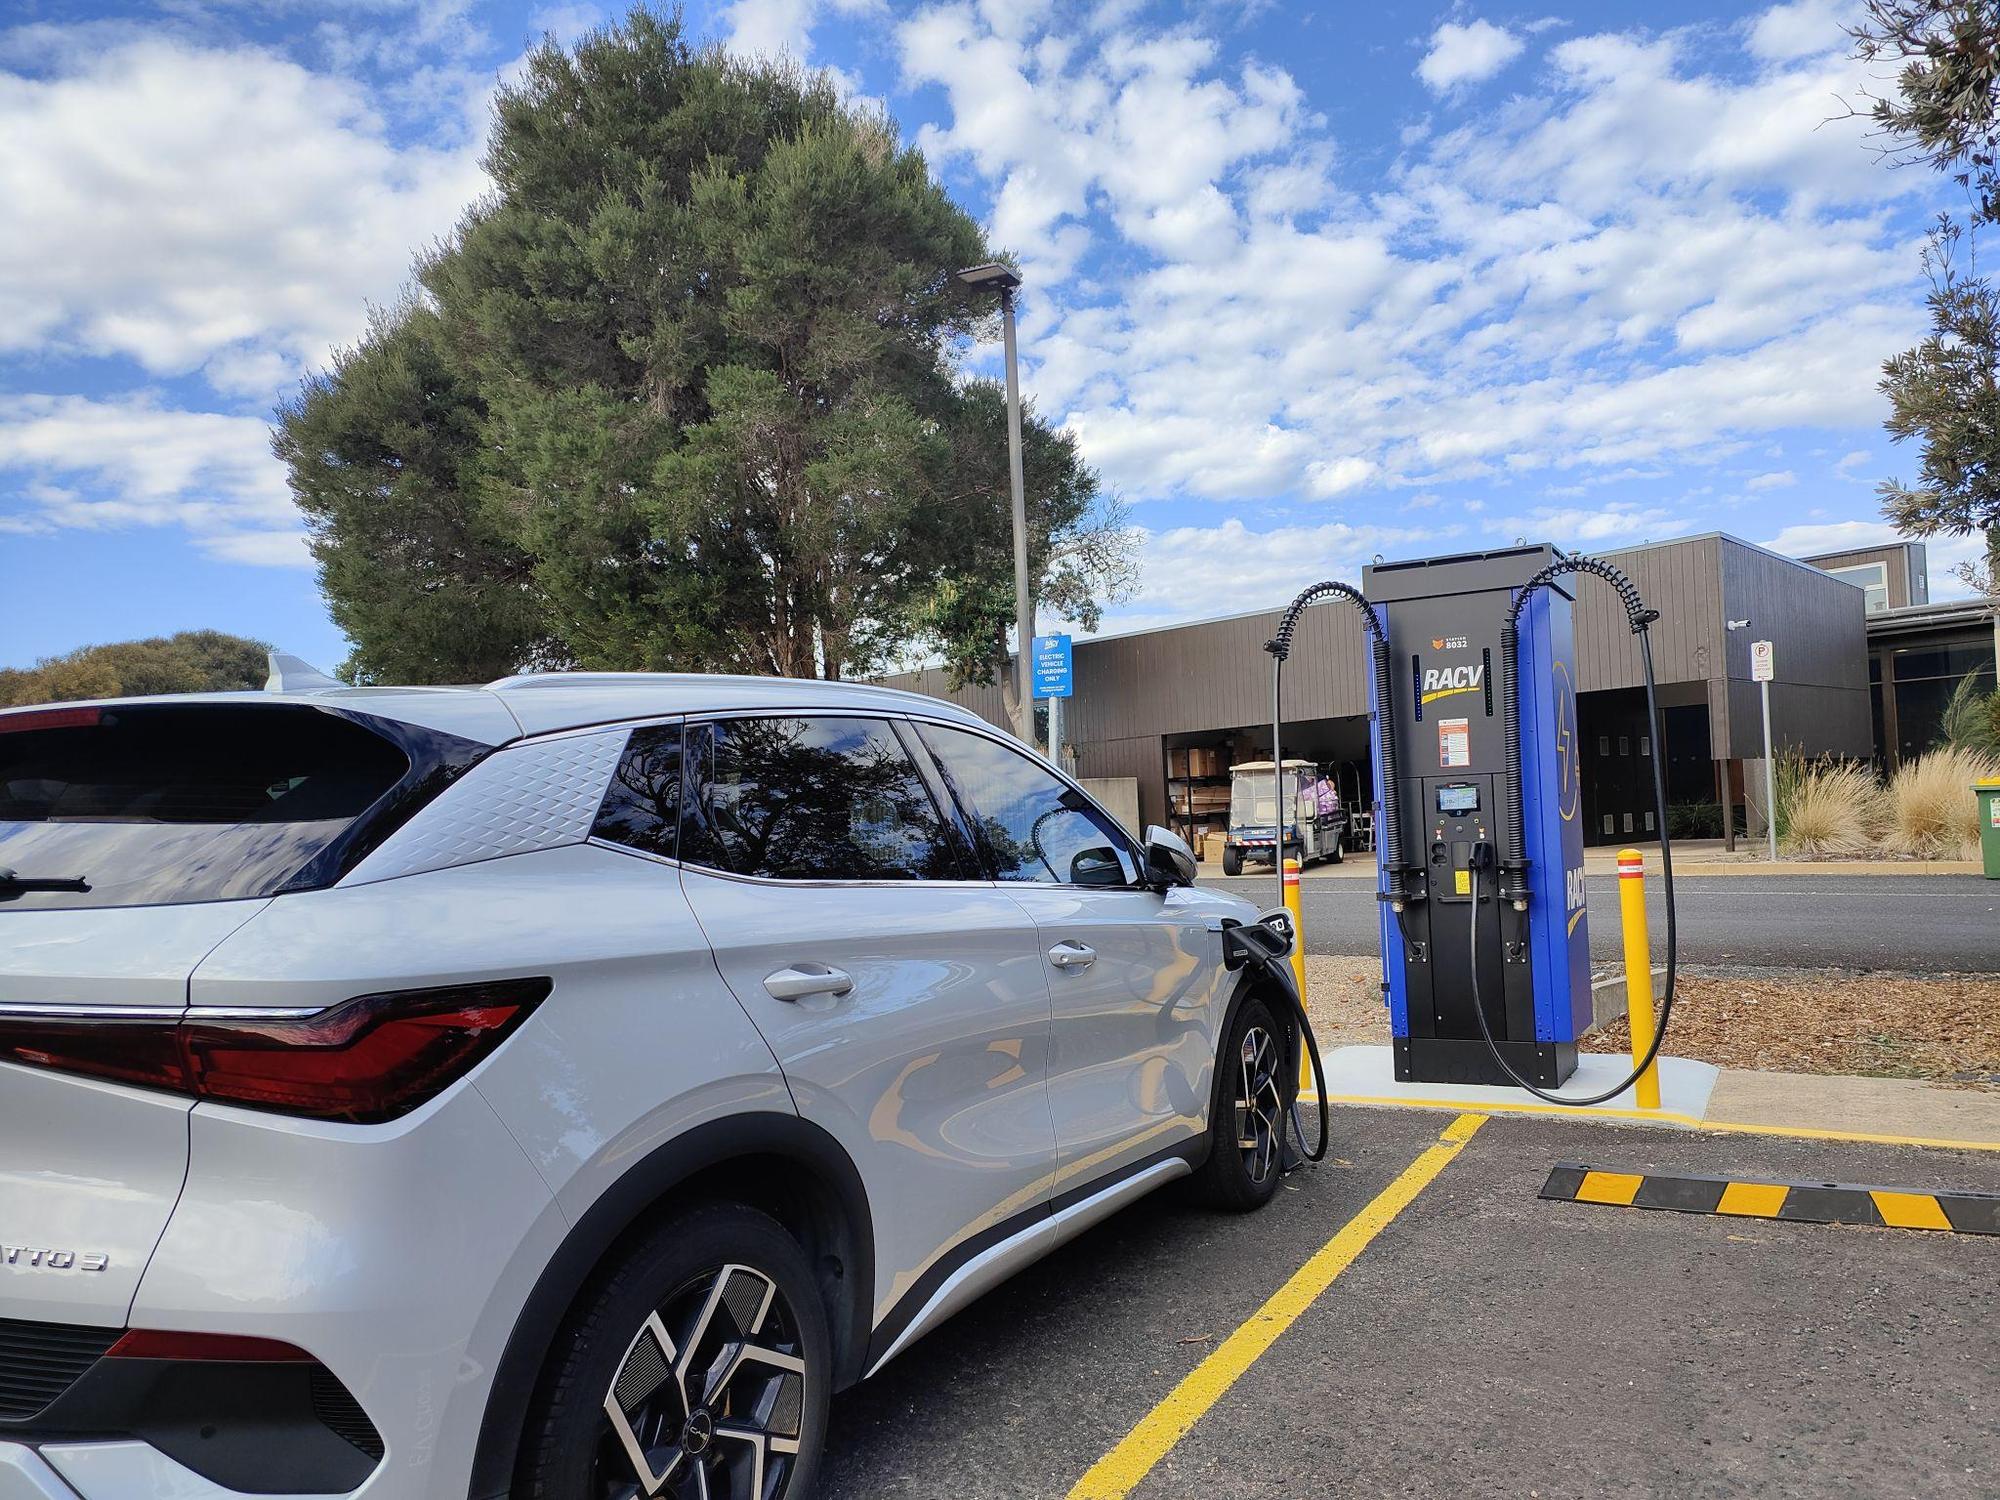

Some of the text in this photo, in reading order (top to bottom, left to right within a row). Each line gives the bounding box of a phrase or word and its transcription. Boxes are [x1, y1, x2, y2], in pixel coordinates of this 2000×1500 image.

[1446, 641, 1467, 649] 8032
[1423, 665, 1484, 690] RACV
[0, 1245, 109, 1272] TTO 3
